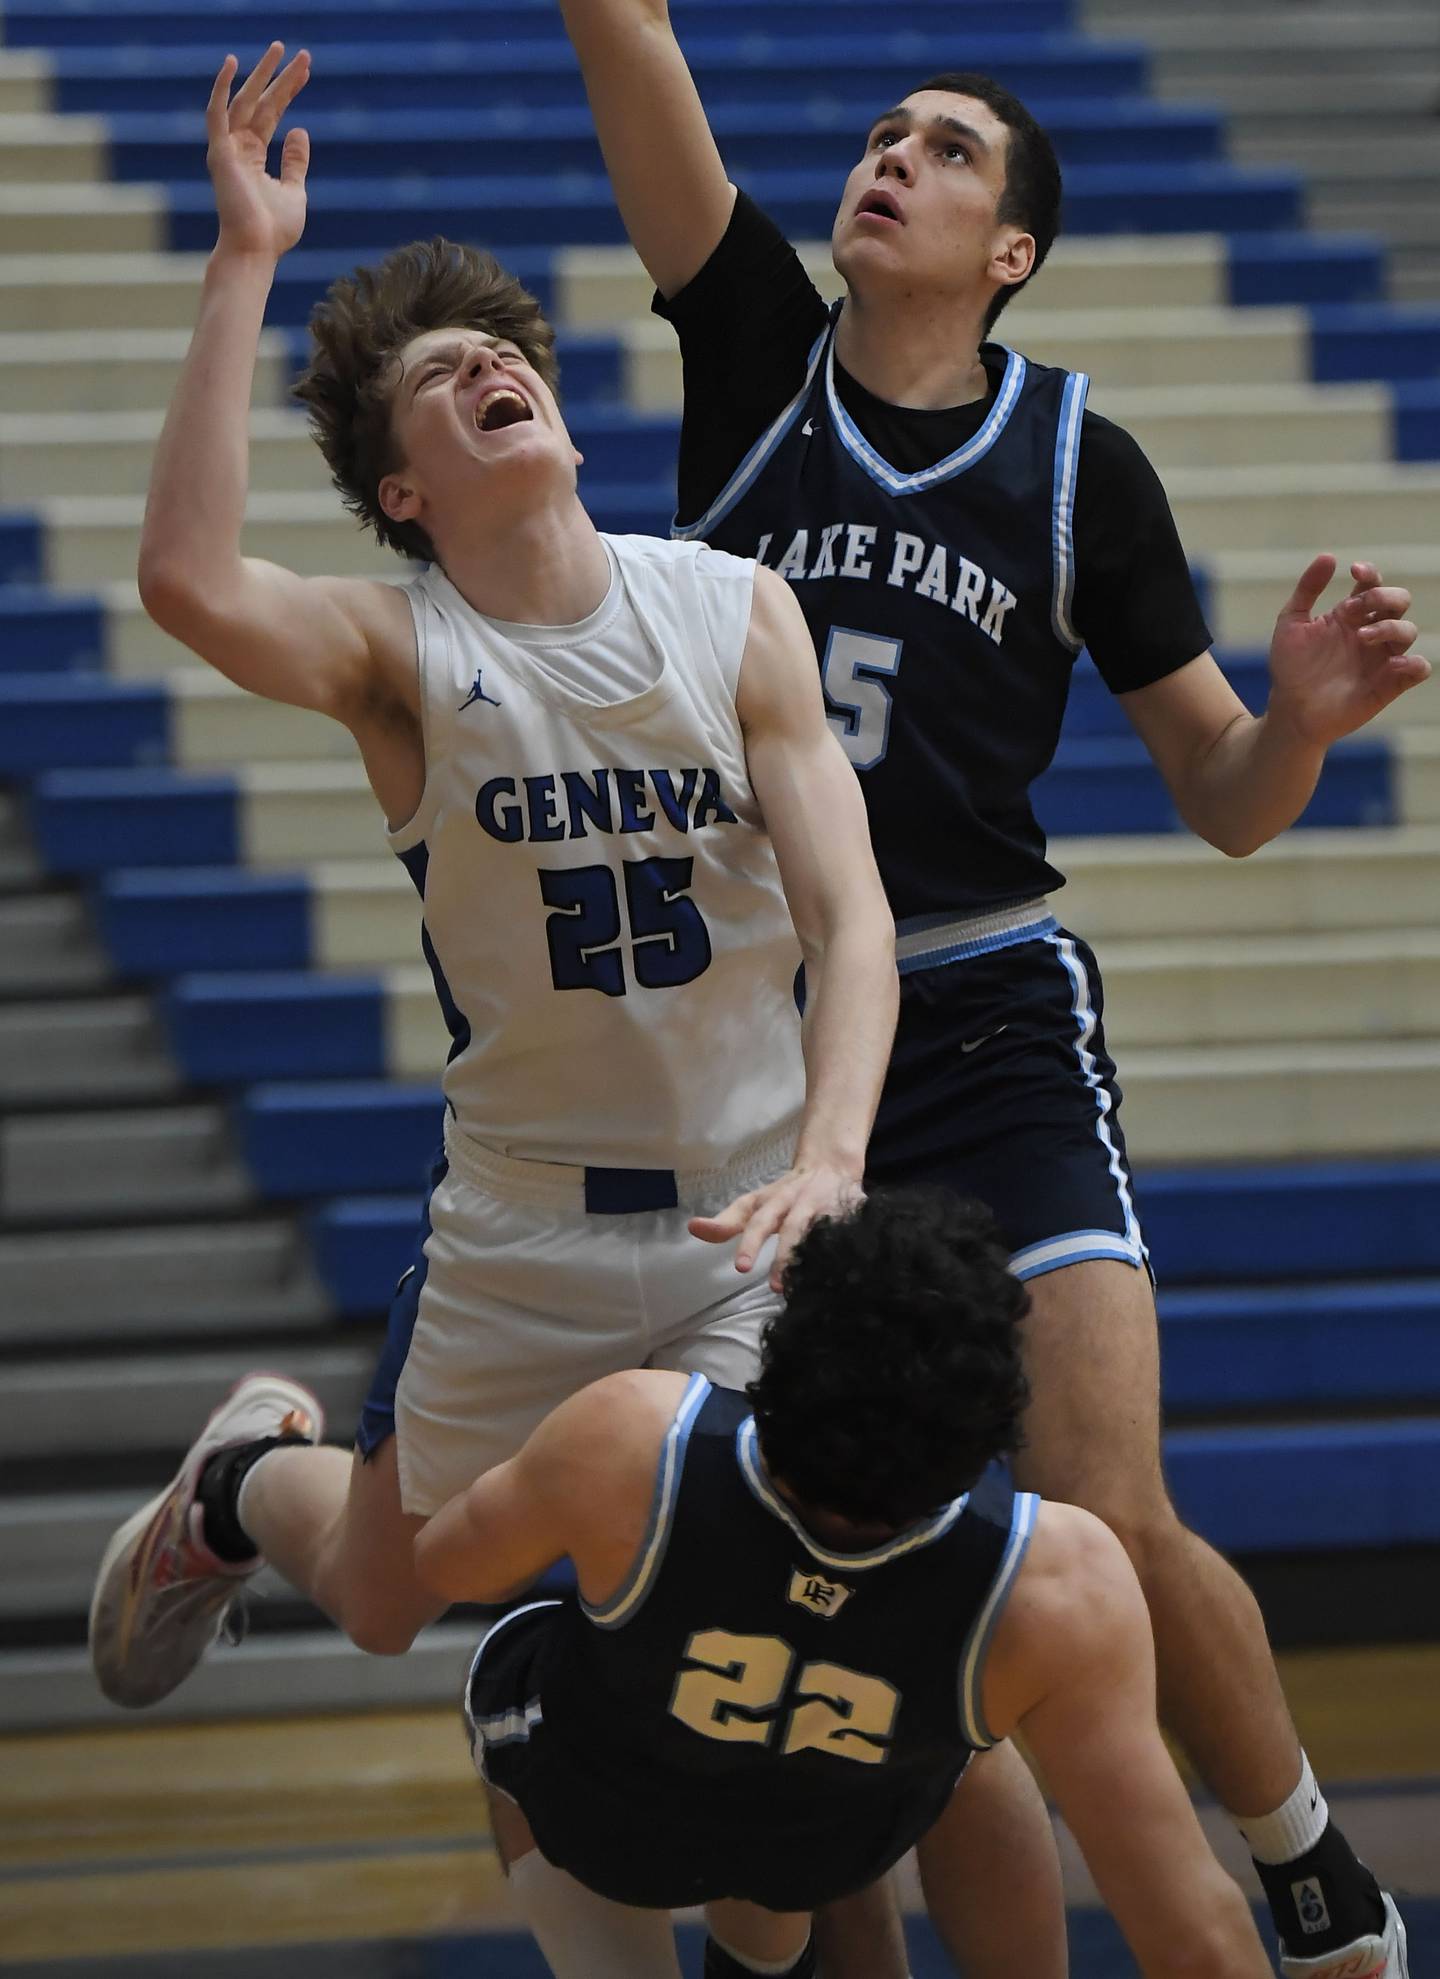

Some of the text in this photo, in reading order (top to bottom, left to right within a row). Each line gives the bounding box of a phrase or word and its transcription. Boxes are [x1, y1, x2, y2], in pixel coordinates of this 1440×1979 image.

[756, 522, 1018, 647] LAKE PARK
[822, 625, 904, 771] 5
[475, 767, 739, 843] GENEVA
[536, 856, 712, 997] 25
[668, 1628, 902, 1765] 22
